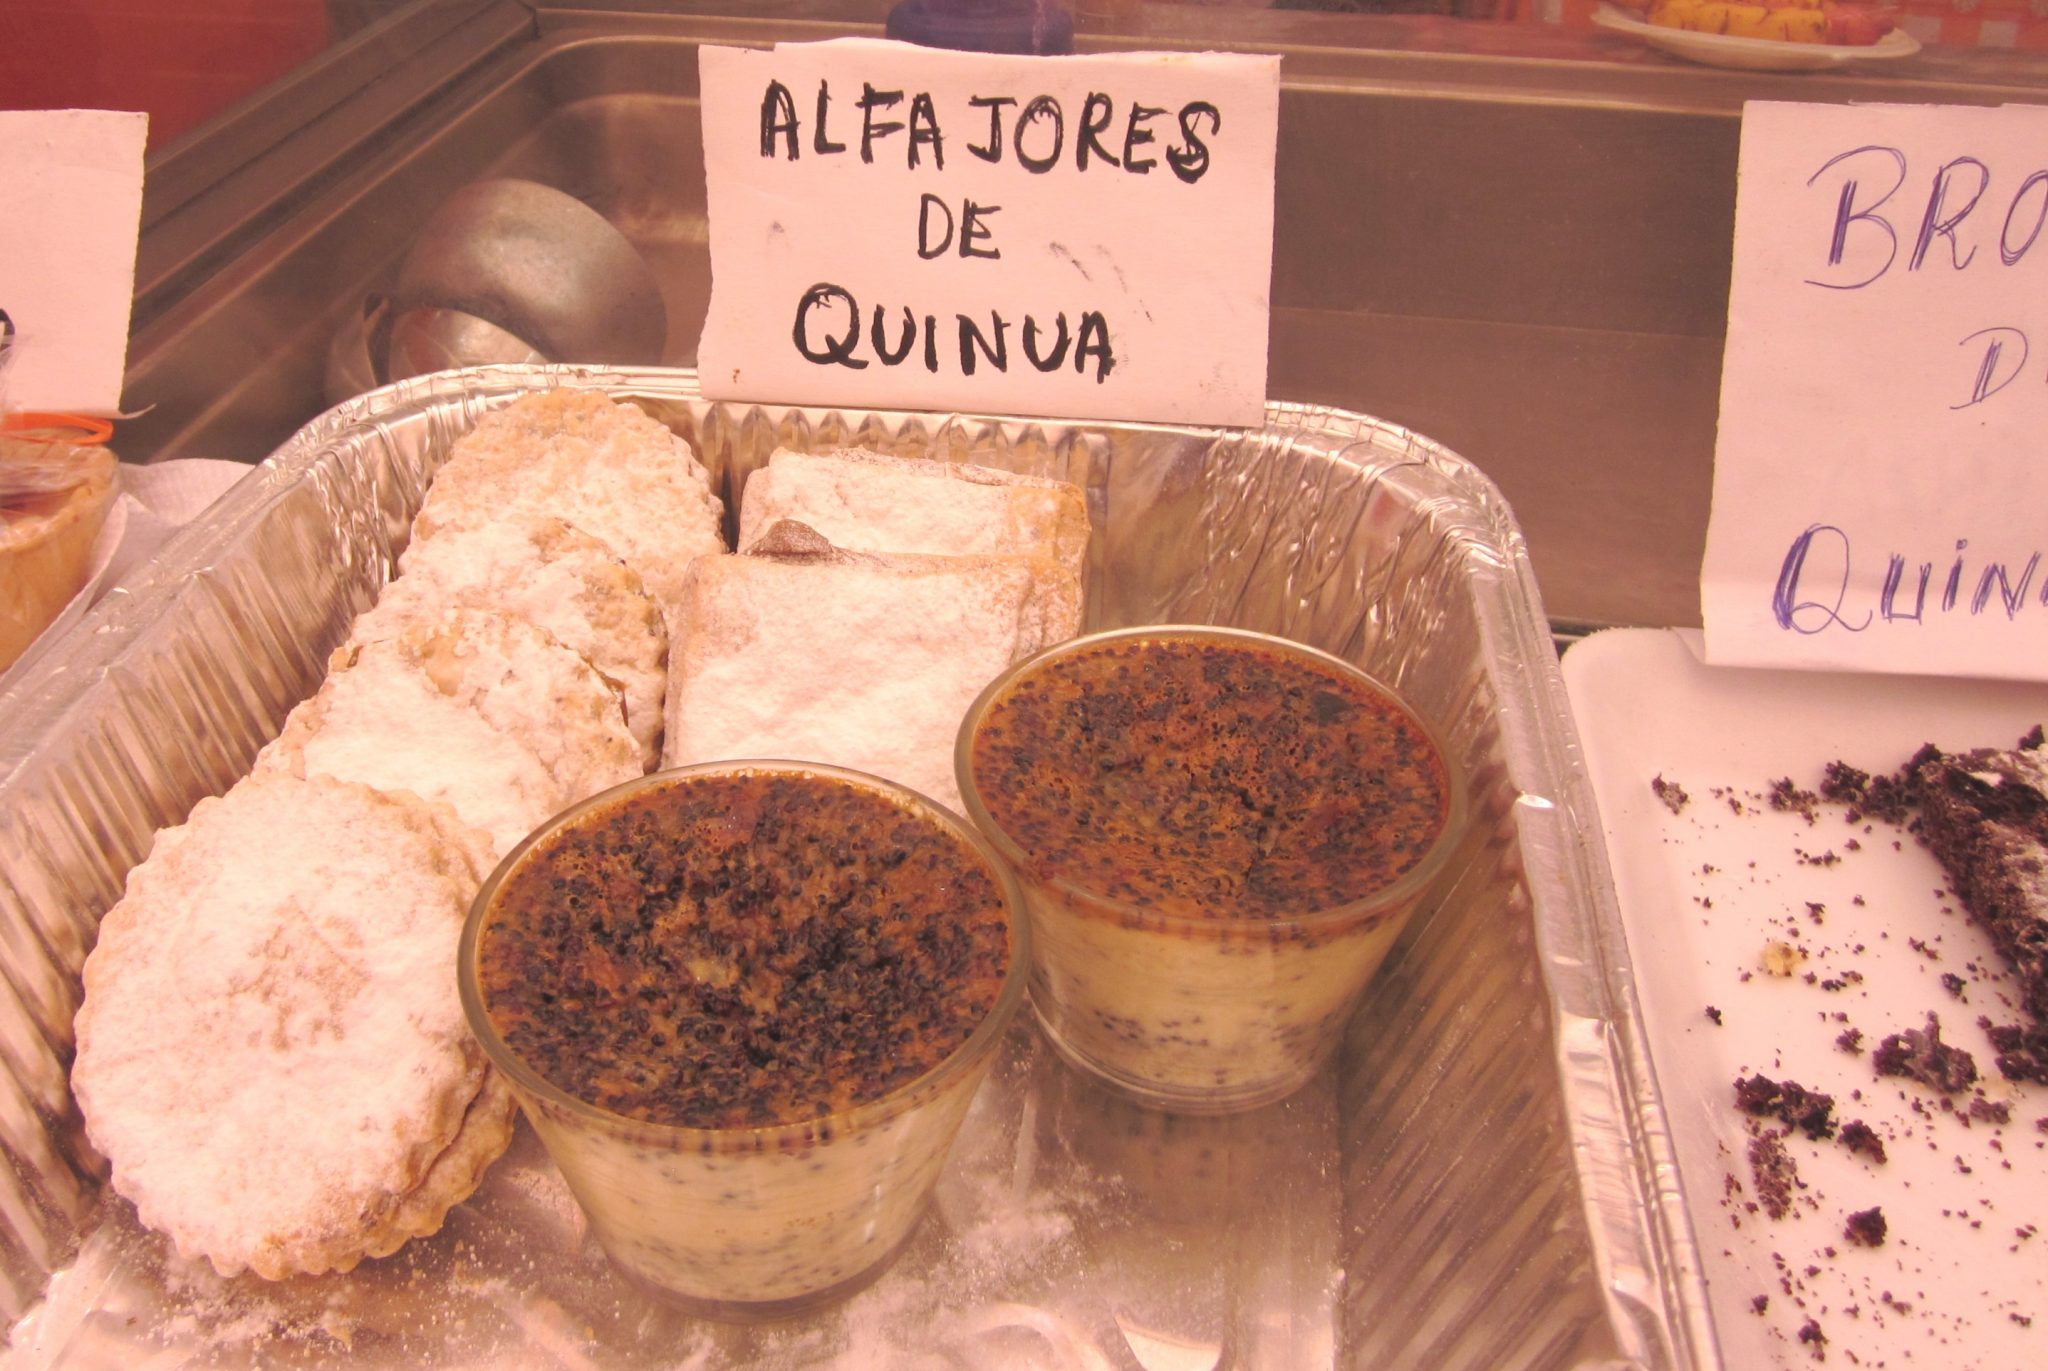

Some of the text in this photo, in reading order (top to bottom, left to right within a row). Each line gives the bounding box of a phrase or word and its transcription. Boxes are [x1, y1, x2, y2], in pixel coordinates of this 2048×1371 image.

[761, 79, 1220, 183] ALFAJORES
[918, 193, 1001, 259] DE
[792, 282, 1117, 384] QUINUA
[1949, 327, 2048, 410] D
